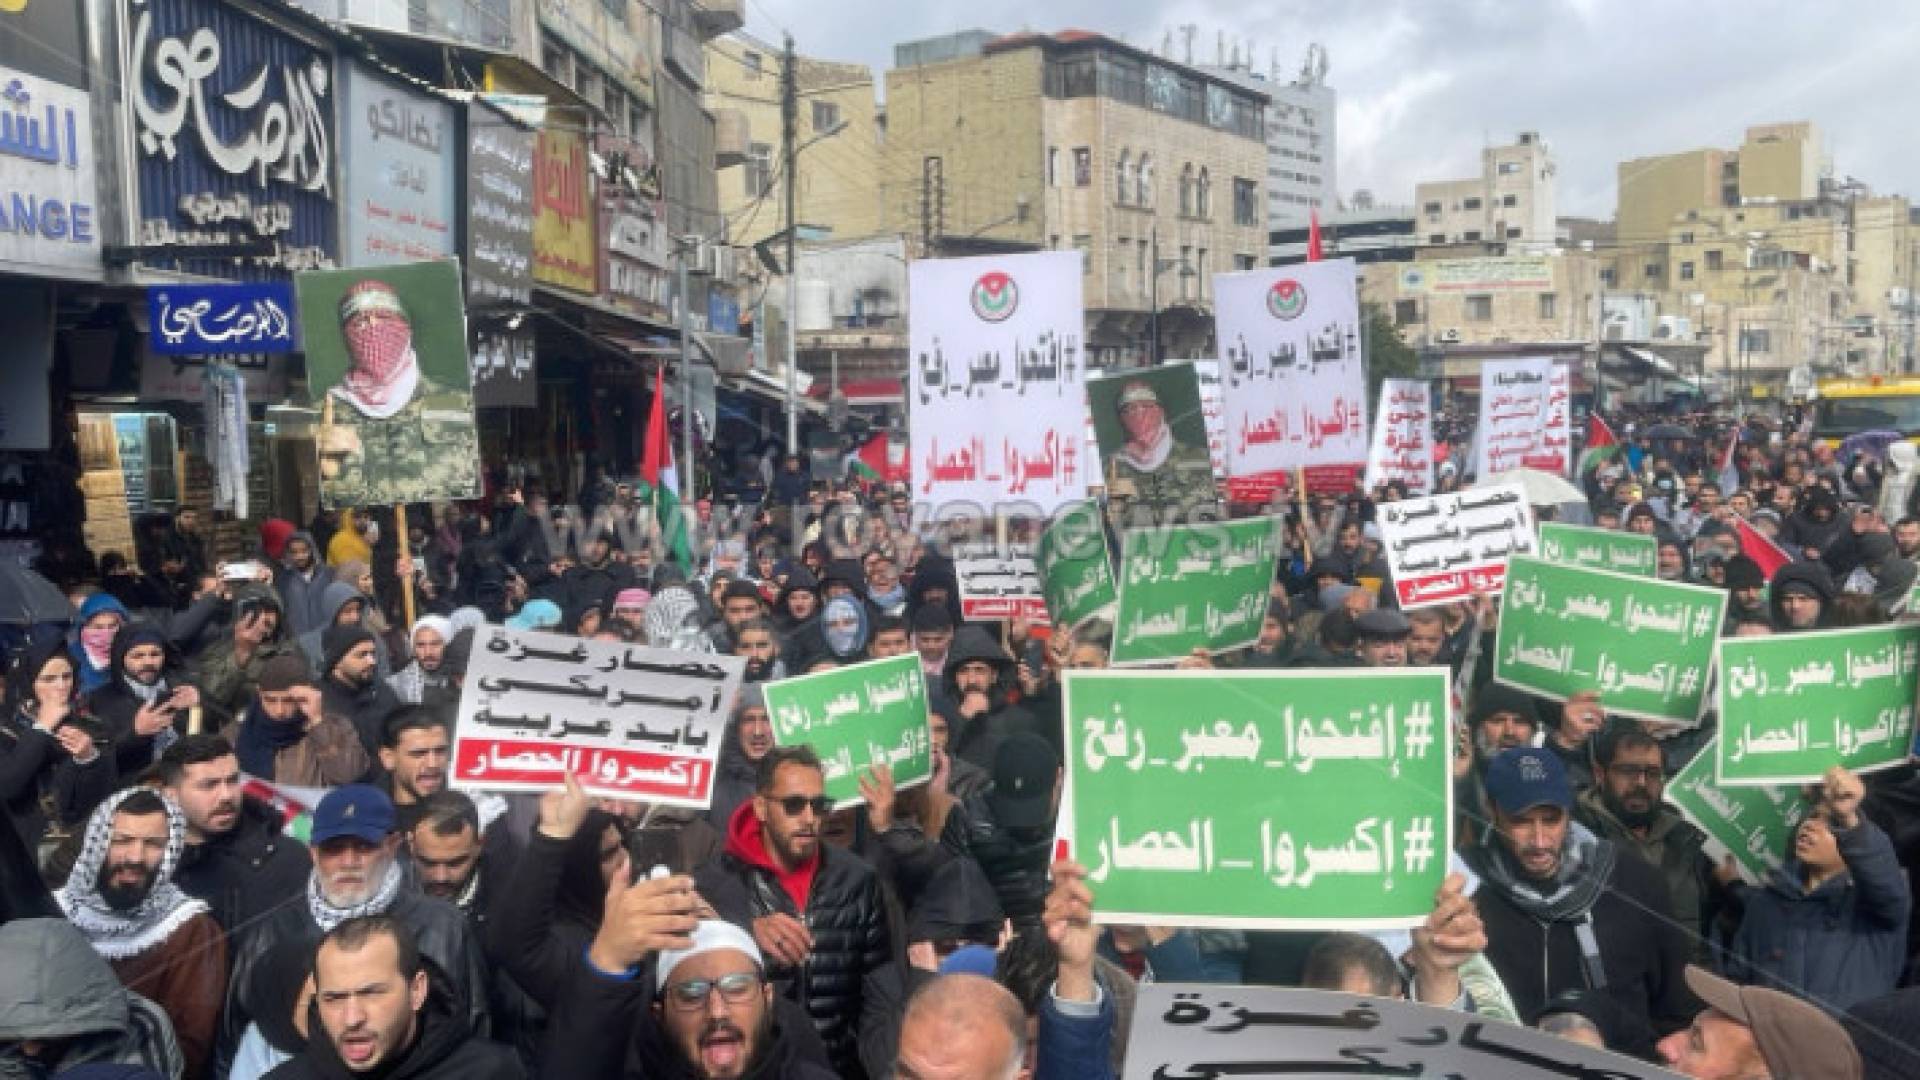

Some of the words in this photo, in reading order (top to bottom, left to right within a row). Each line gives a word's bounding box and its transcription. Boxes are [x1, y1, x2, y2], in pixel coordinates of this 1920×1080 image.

[486, 630, 588, 663] غزة
[595, 649, 728, 681] حصار
[477, 673, 721, 713] أمريكي
[473, 697, 612, 738] عربية
[467, 743, 580, 776] الحصار
[592, 751, 703, 797] إكسروا
[1162, 993, 1380, 1033] غزة
